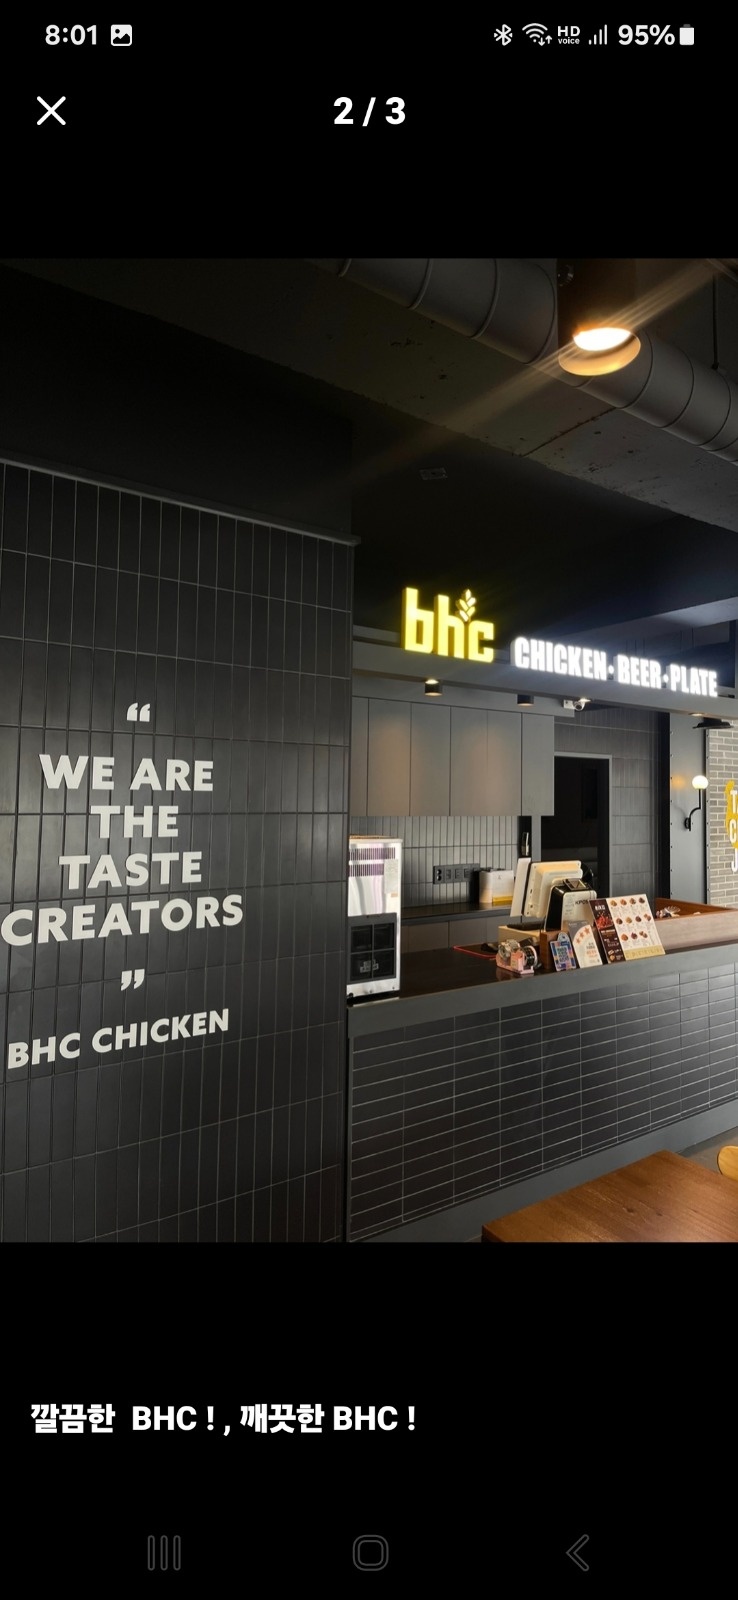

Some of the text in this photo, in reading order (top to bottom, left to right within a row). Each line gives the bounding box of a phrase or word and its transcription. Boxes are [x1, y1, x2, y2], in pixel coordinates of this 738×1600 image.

[402, 587, 495, 664] bhc
[38, 753, 214, 792] WE ARE
[90, 804, 180, 838] THE
[58, 850, 203, 890] TASTE
[0, 894, 244, 946] CREATORS
[7, 1008, 230, 1070] BHC CHICKEN
